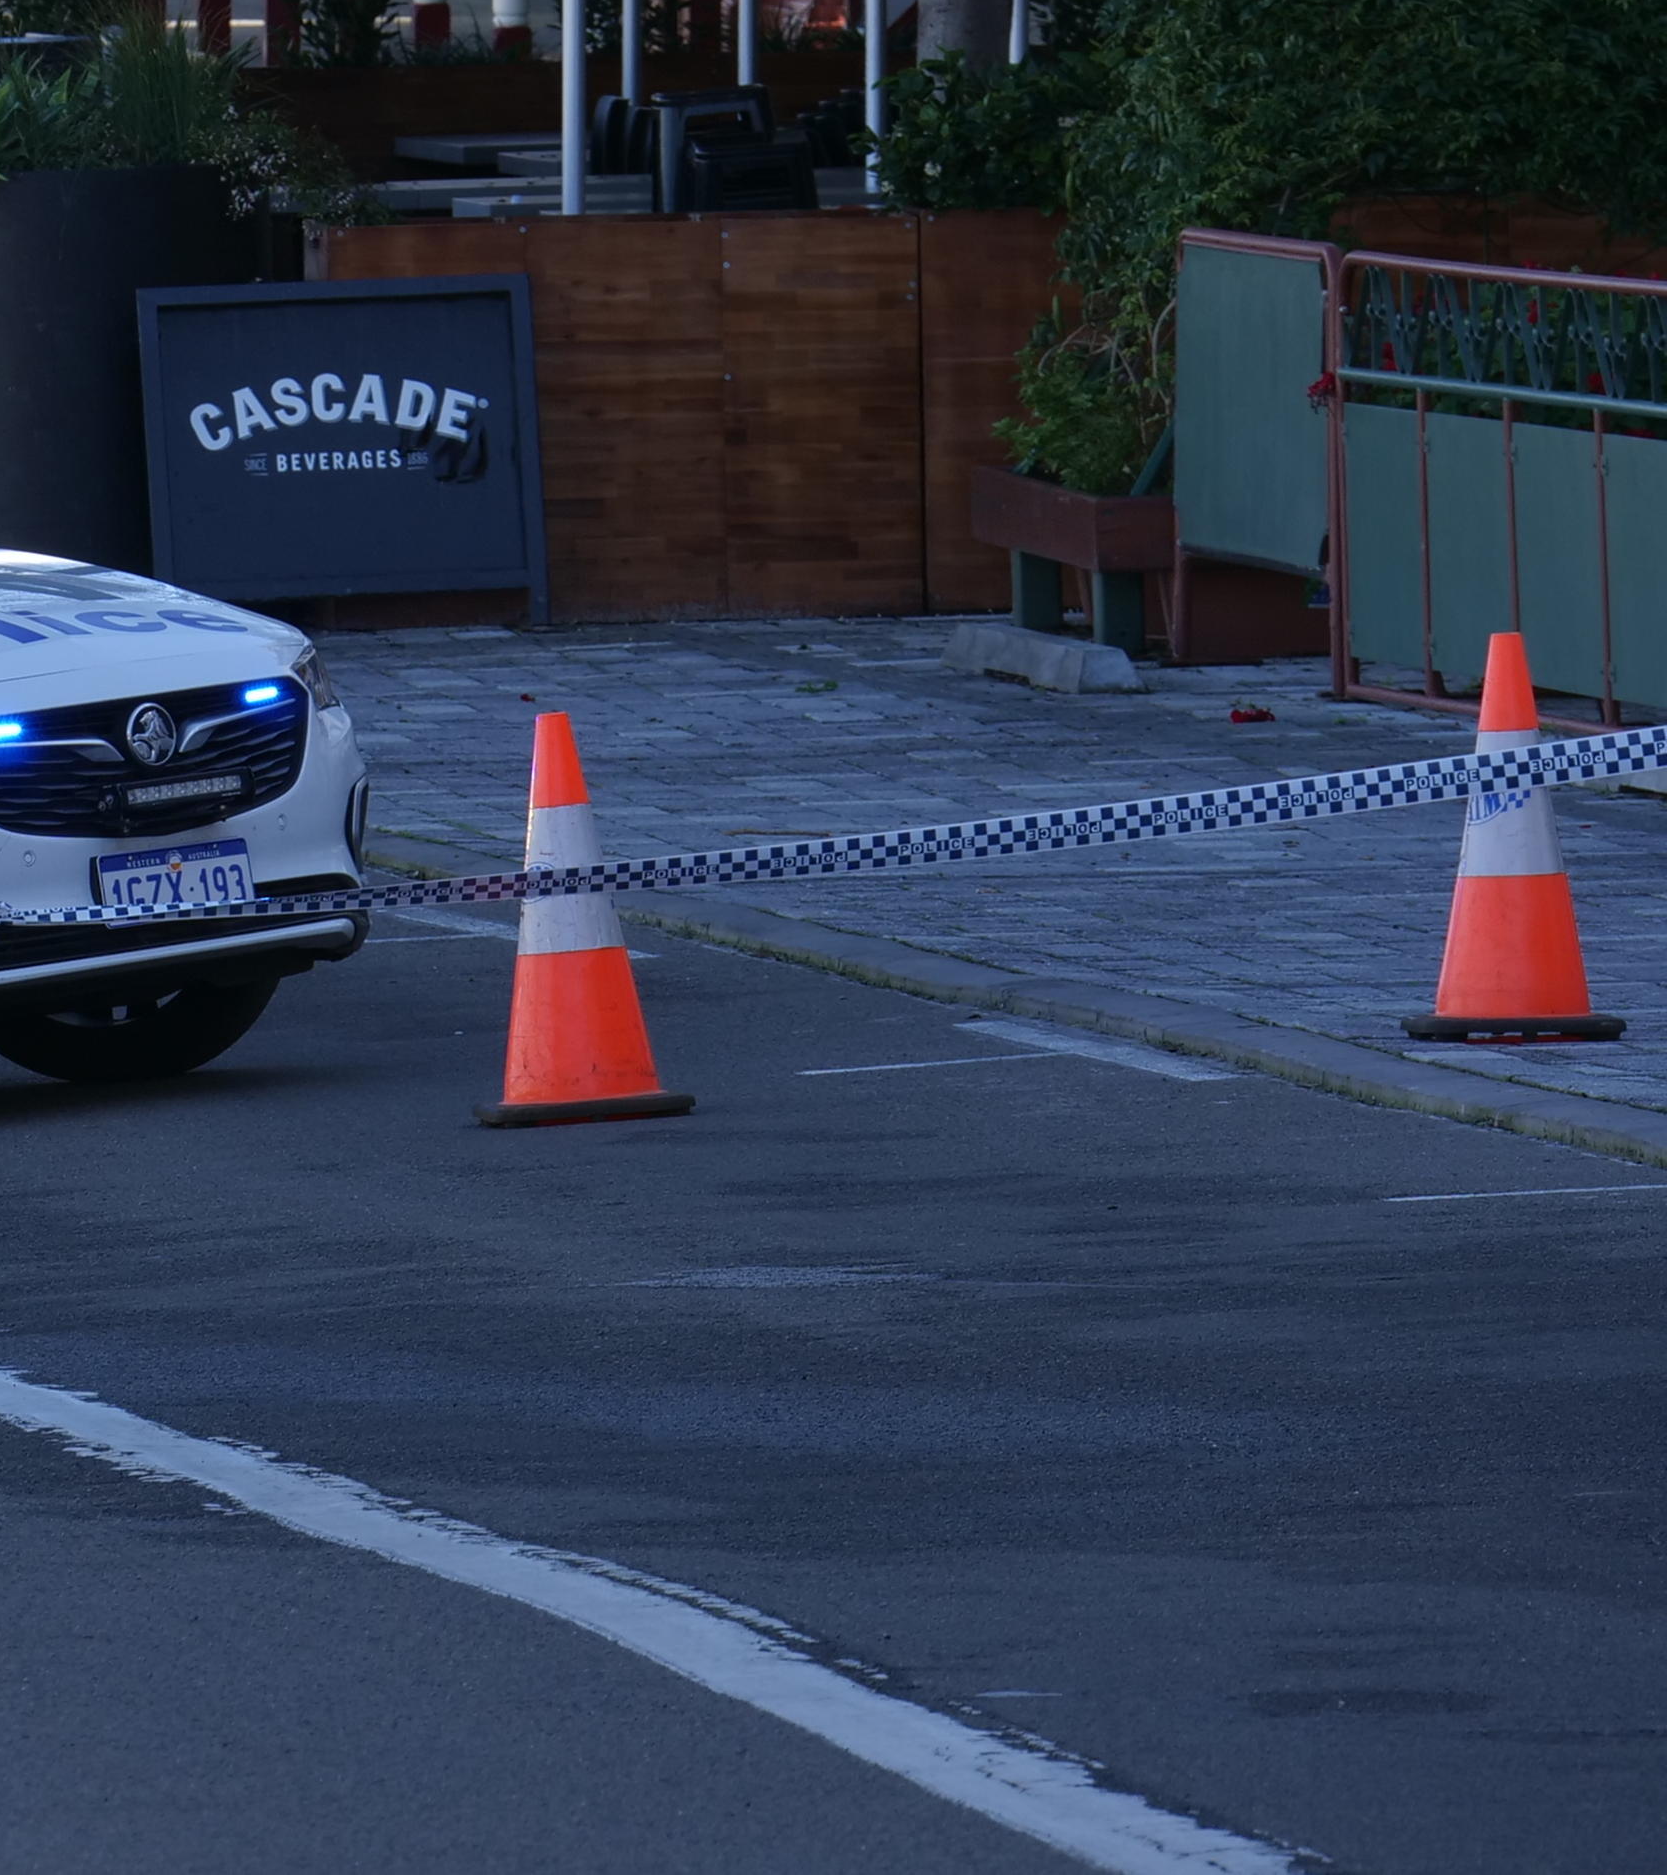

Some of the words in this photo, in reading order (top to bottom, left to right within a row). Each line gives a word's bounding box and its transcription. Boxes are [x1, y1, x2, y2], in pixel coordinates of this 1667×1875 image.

[189, 373, 477, 451] CASCADE
[275, 449, 402, 472] BEVERAGES
[1405, 769, 1480, 790] POLICE
[1152, 804, 1229, 826] POLICE
[186, 849, 221, 861] AUSTRALIA
[898, 836, 975, 856] POLICE
[642, 864, 720, 881] POLICE
[385, 886, 464, 899] POLICE
